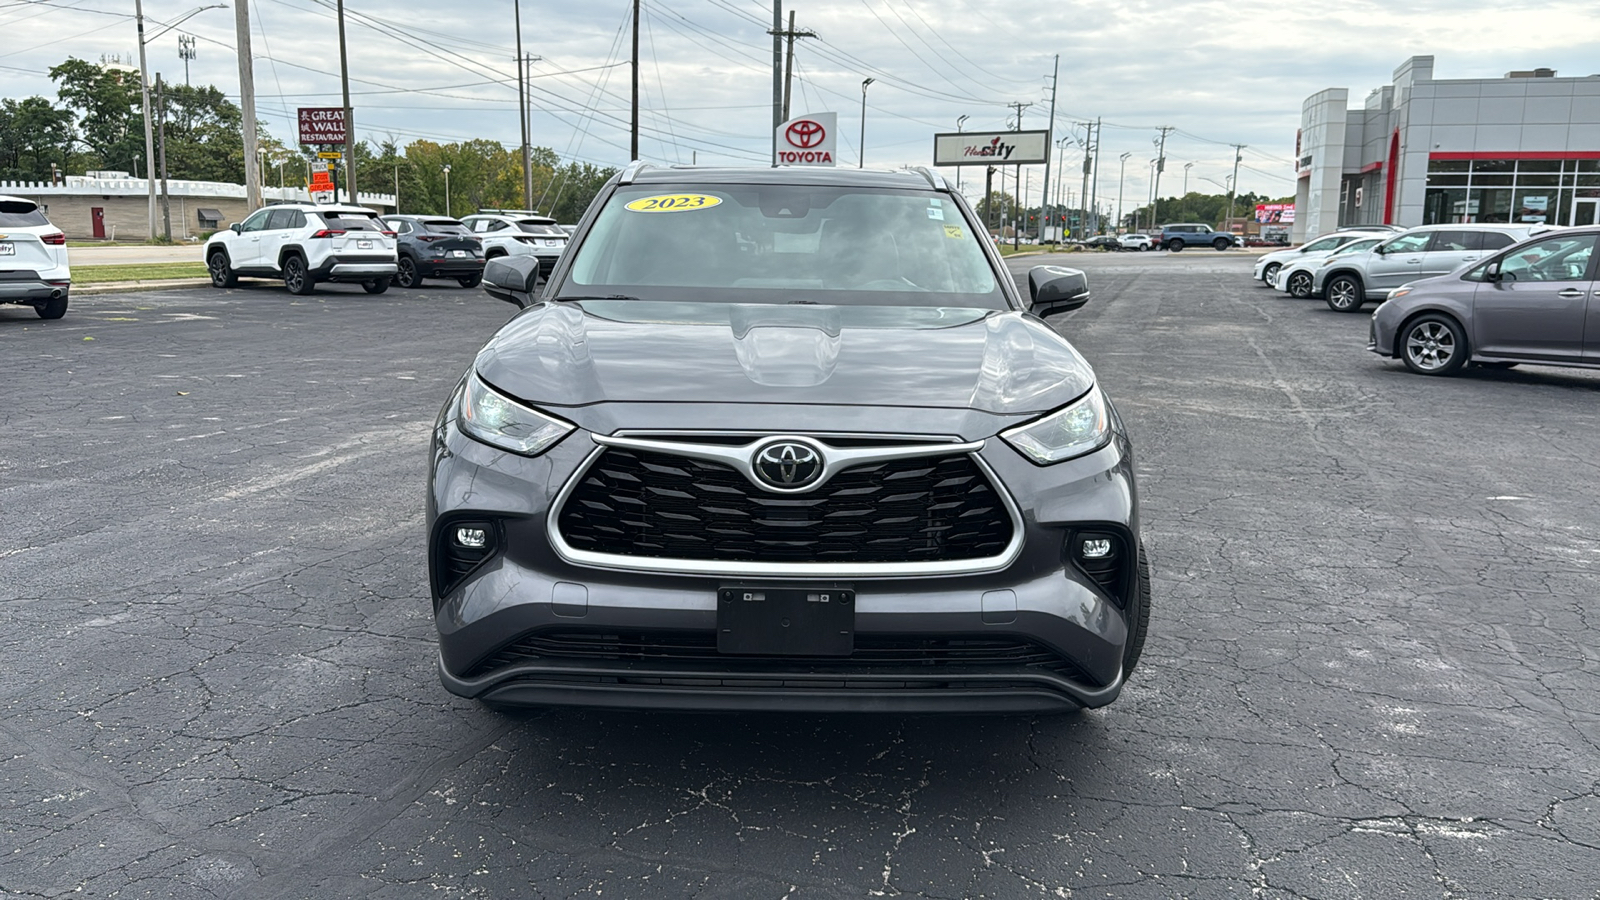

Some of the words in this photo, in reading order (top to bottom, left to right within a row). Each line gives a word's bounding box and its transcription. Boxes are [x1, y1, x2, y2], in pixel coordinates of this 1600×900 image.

[311, 111, 344, 121] GREAT
[312, 122, 346, 131] WALL
[778, 151, 832, 163] TOYOTA
[642, 197, 706, 210] 2023
